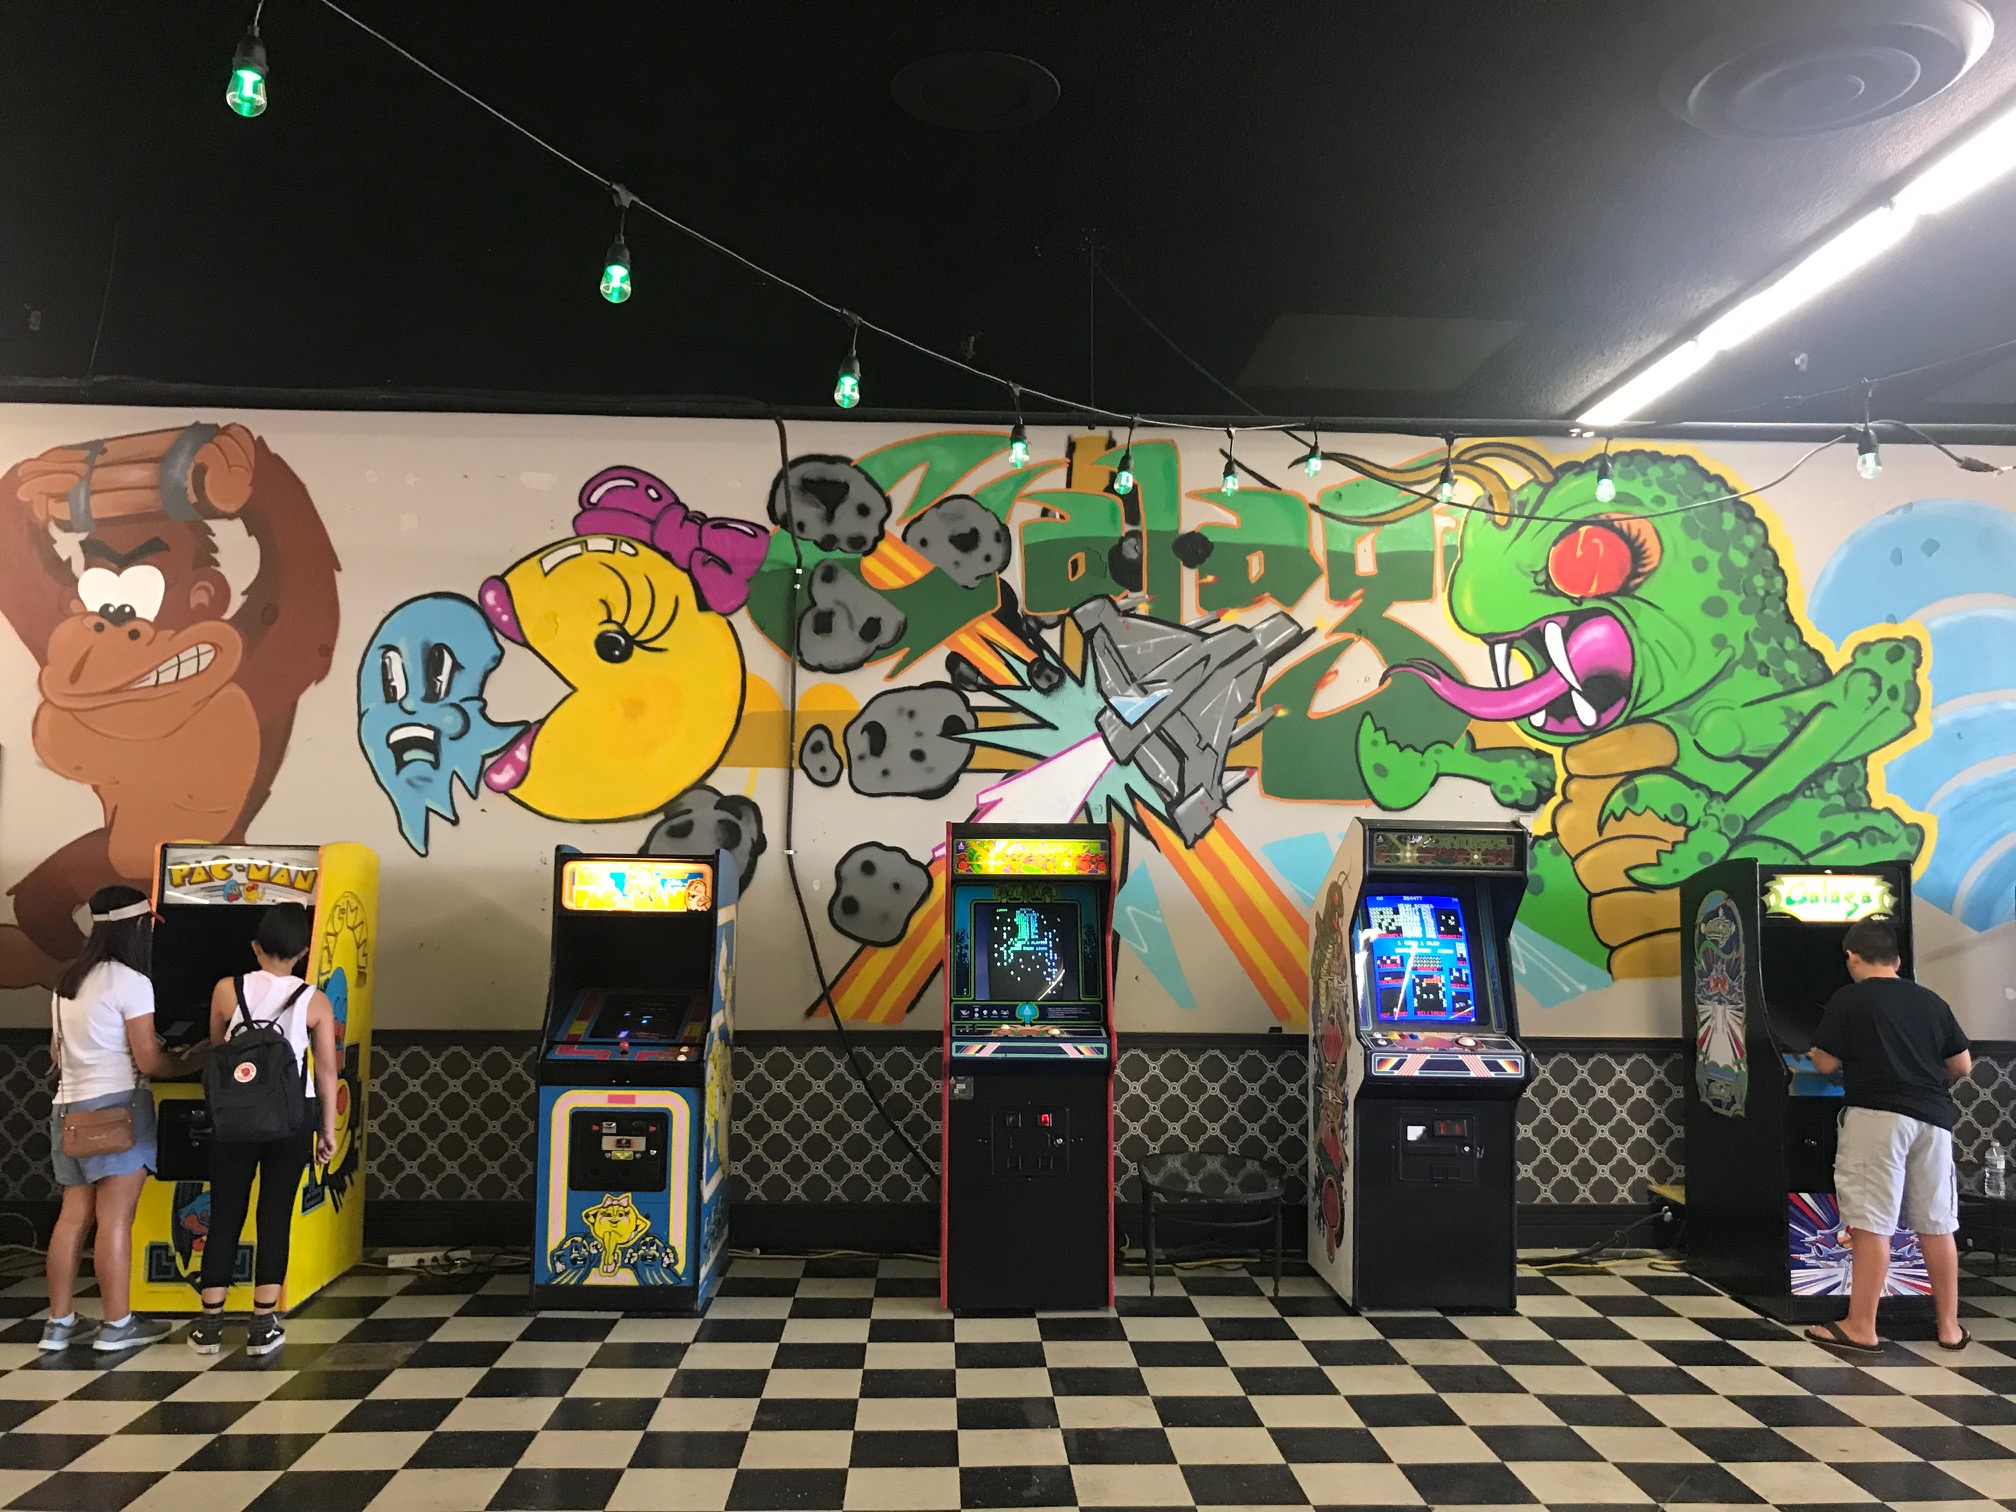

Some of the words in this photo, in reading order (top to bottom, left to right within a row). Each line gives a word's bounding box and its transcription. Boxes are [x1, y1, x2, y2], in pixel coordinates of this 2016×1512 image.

[745, 430, 1472, 804] Galag
[169, 855, 318, 894] PAC-MAN
[1785, 881, 1872, 917] Galaga
